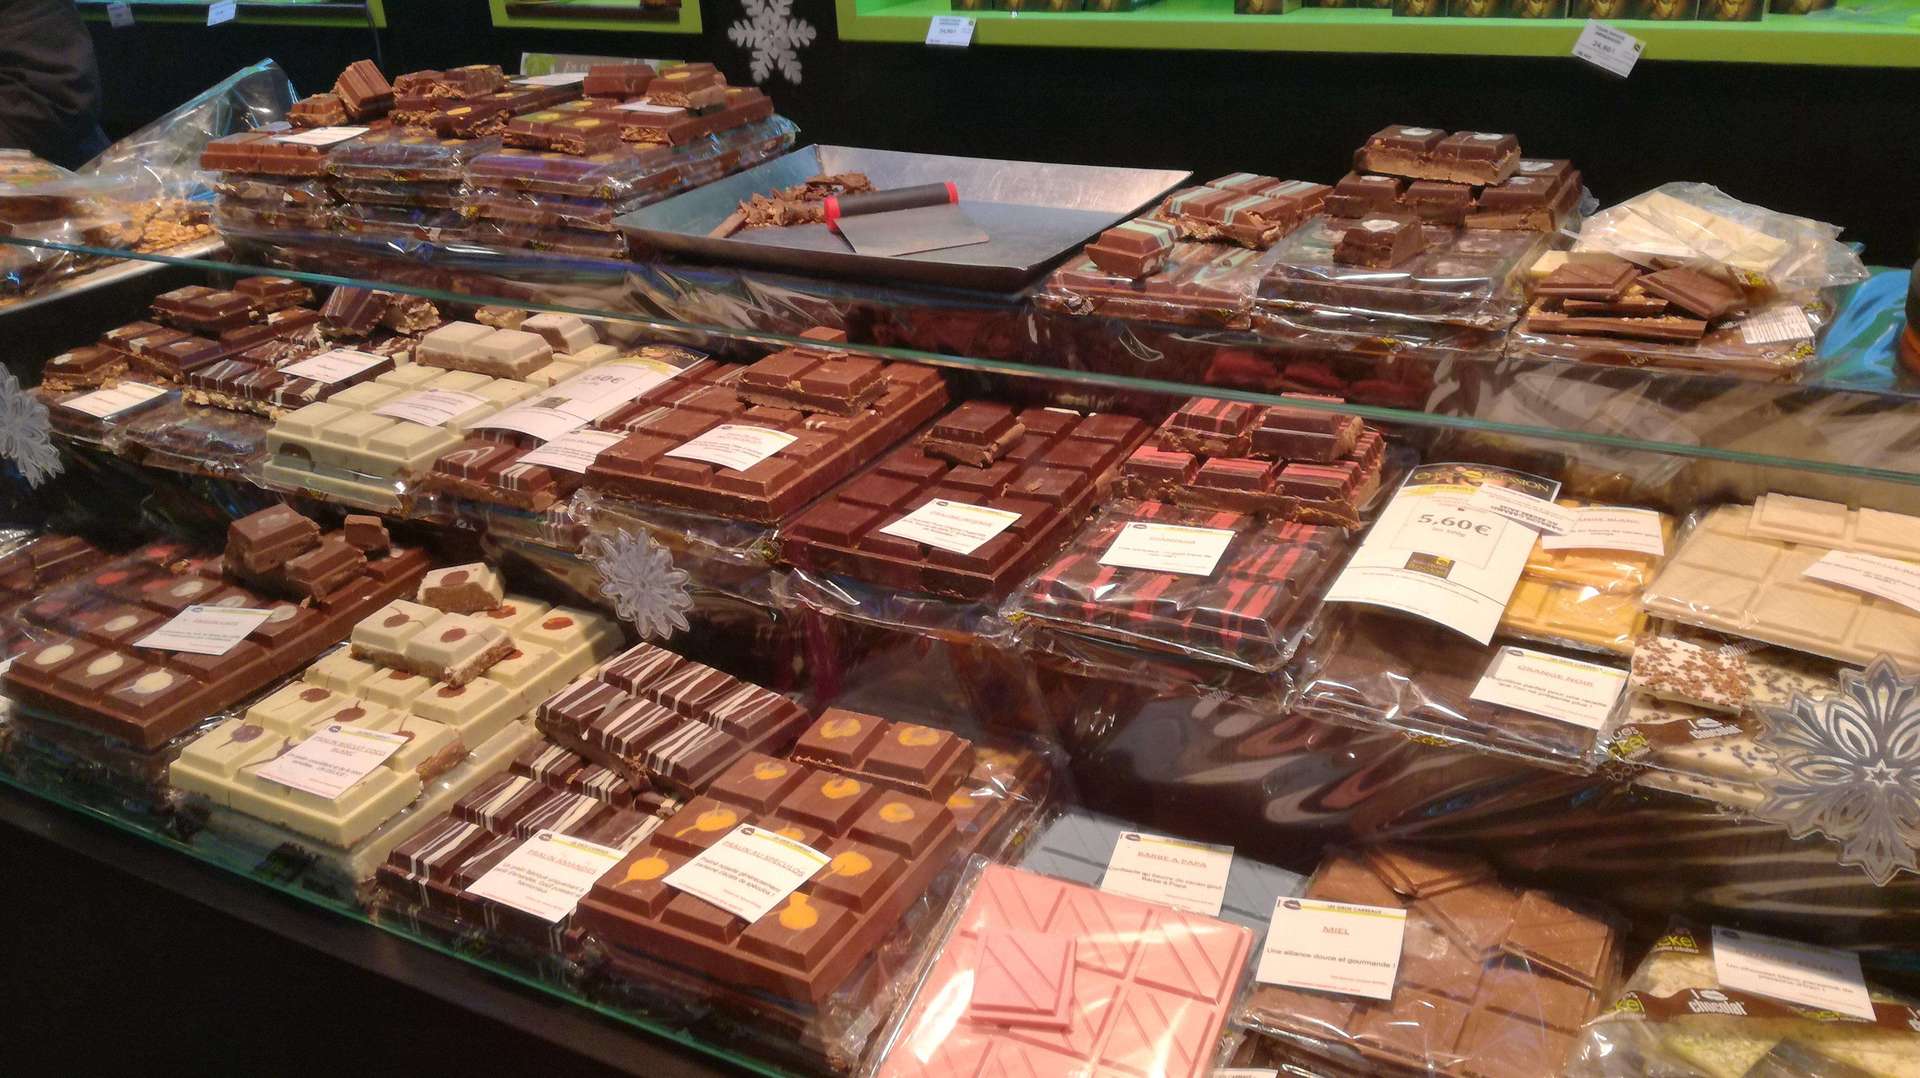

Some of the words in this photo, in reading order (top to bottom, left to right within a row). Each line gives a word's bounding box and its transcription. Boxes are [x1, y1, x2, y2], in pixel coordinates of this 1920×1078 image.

[1417, 513, 1492, 536] 5,60€
[1322, 925, 1350, 936] MIEL
[1267, 947, 1282, 956] Une
[1284, 949, 1313, 960] alliance
[1313, 953, 1337, 963] douce
[1338, 955, 1347, 964] et
[1348, 958, 1391, 969] gourmande
